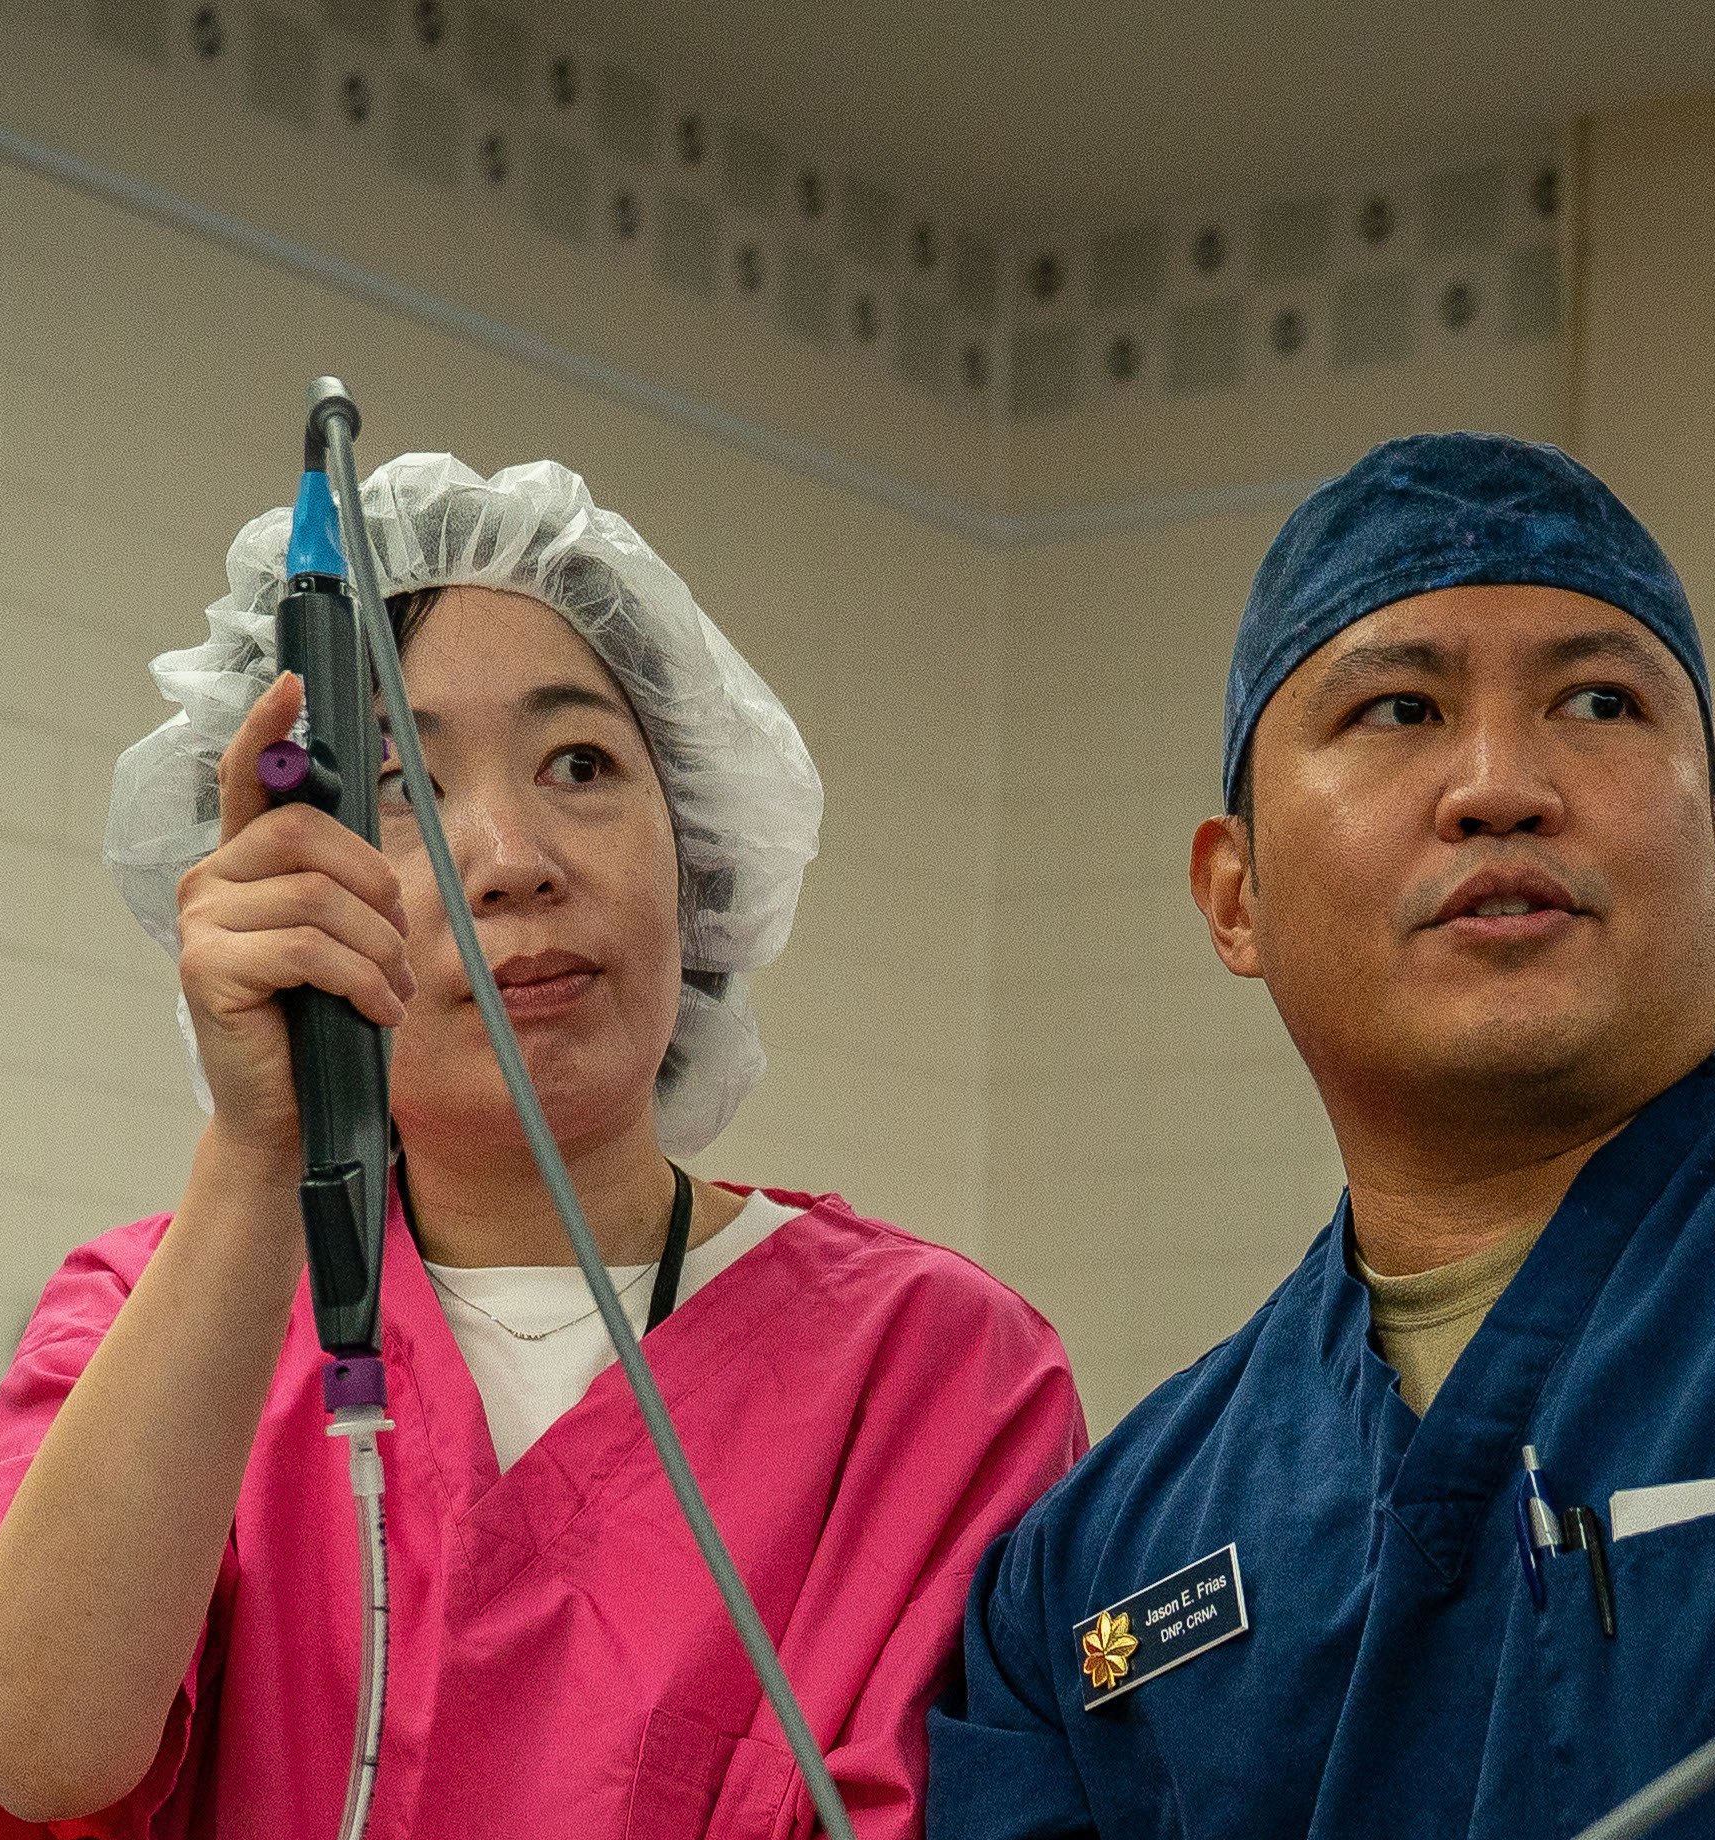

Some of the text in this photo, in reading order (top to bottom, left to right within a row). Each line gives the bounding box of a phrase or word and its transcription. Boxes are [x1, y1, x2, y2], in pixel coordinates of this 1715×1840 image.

[1145, 1575, 1227, 1626] Jason E. Frias
[1160, 1604, 1218, 1643] DNP, CRNA
